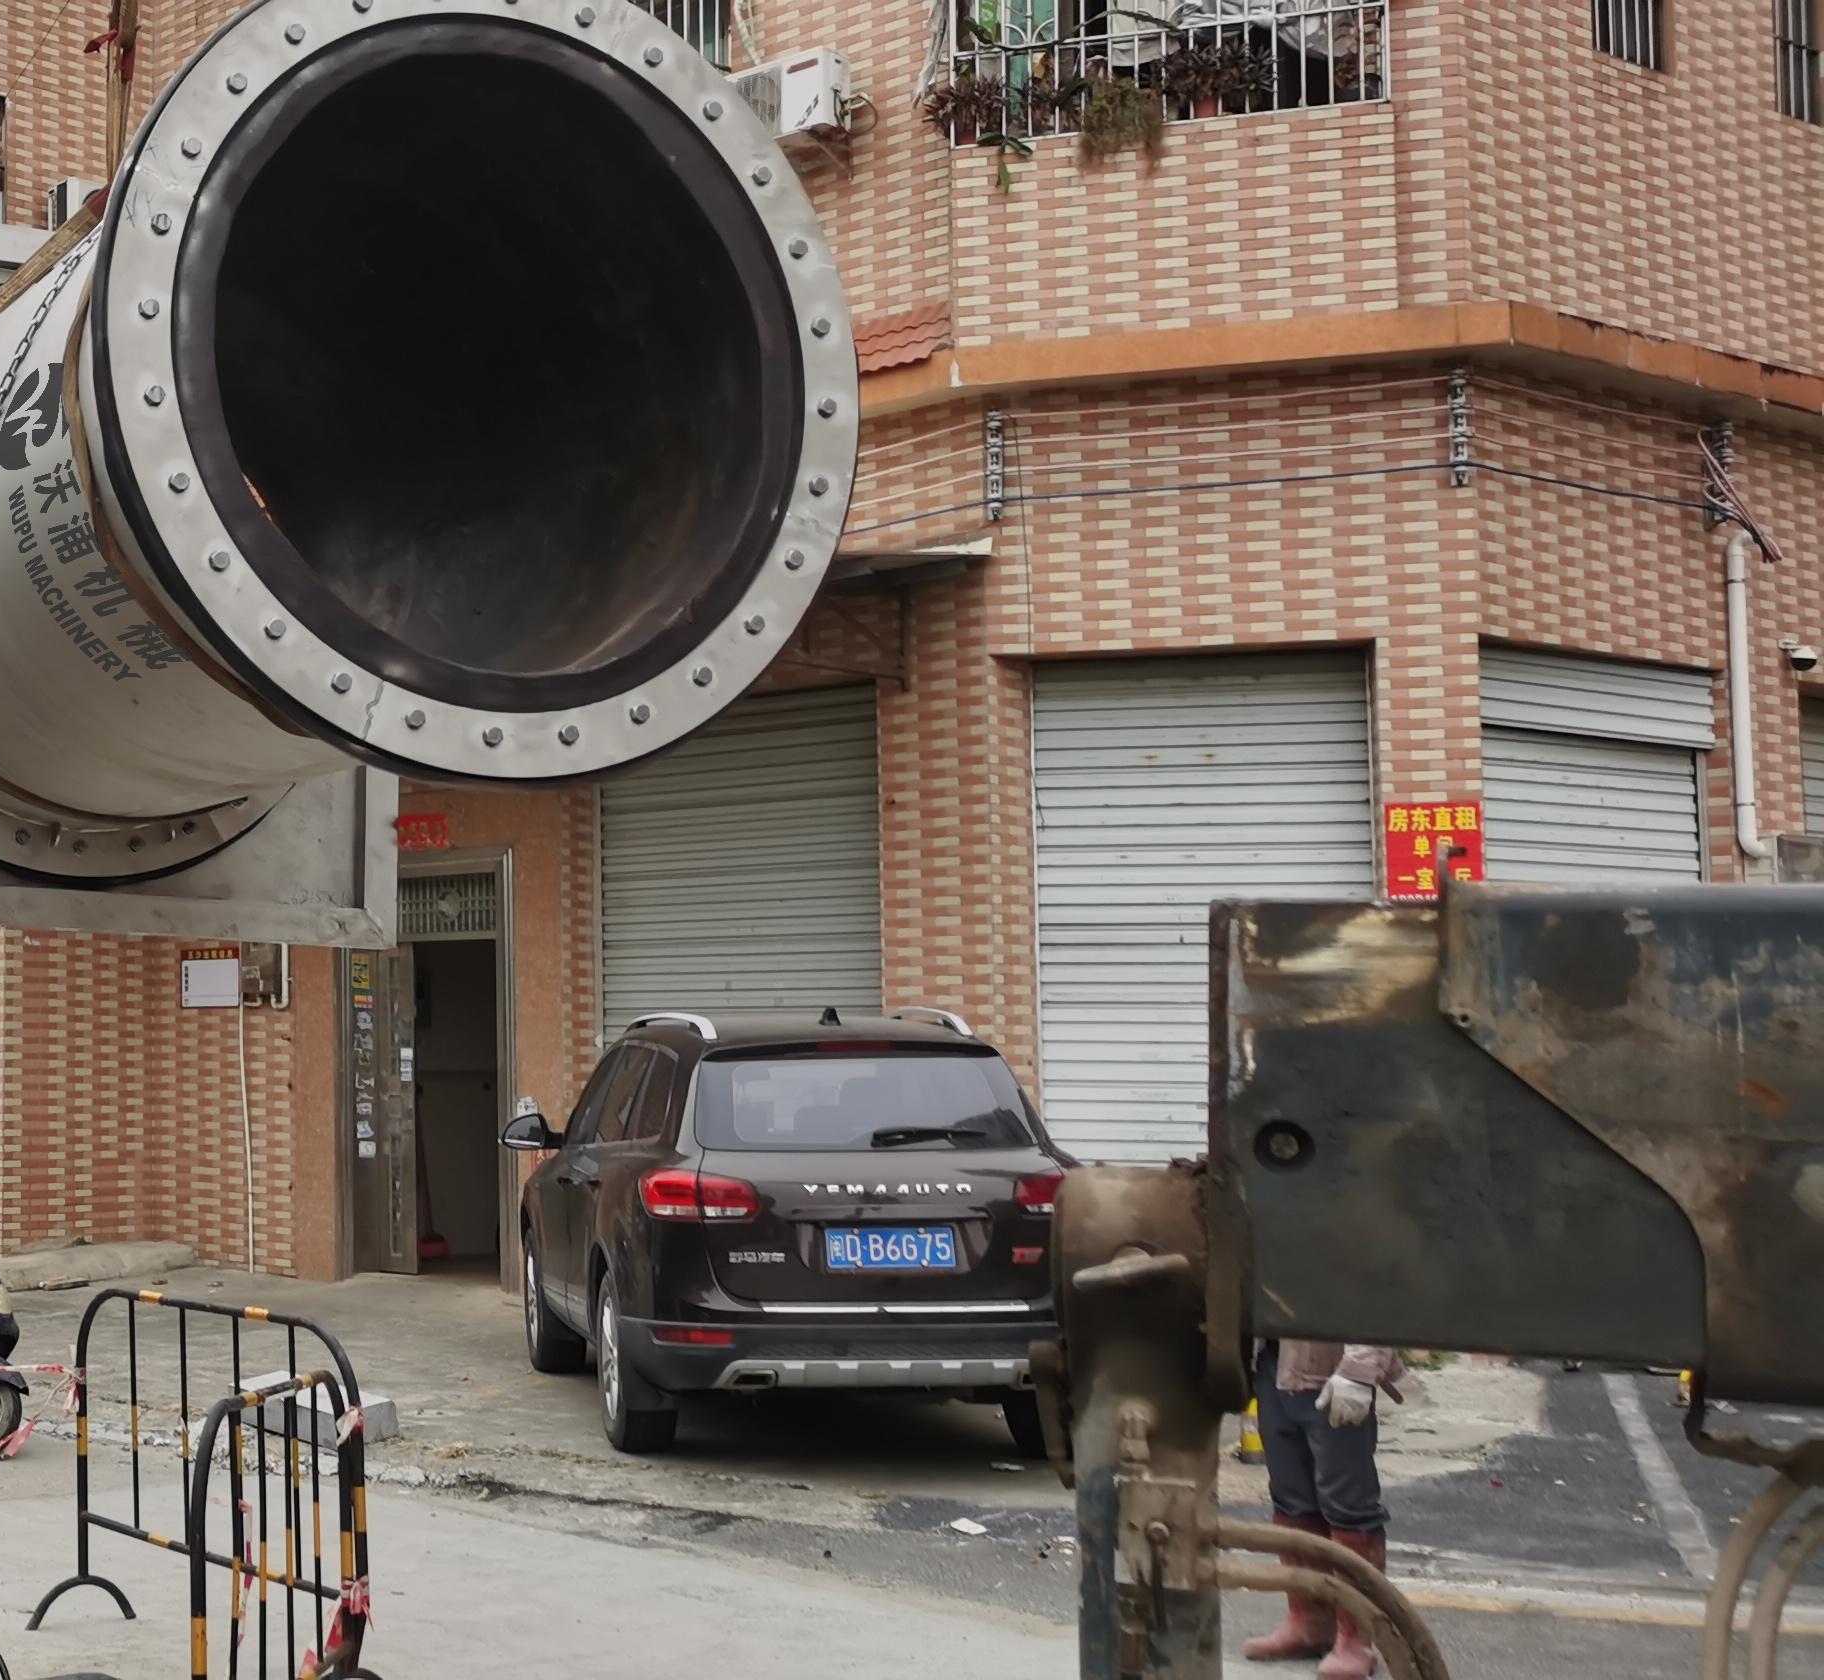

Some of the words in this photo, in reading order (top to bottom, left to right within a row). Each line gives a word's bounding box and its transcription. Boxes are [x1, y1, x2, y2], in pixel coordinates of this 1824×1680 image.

[8, 485, 38, 553] WUPU
[24, 554, 142, 681] MACHINERY
[1388, 806, 1478, 832] 房东直租
